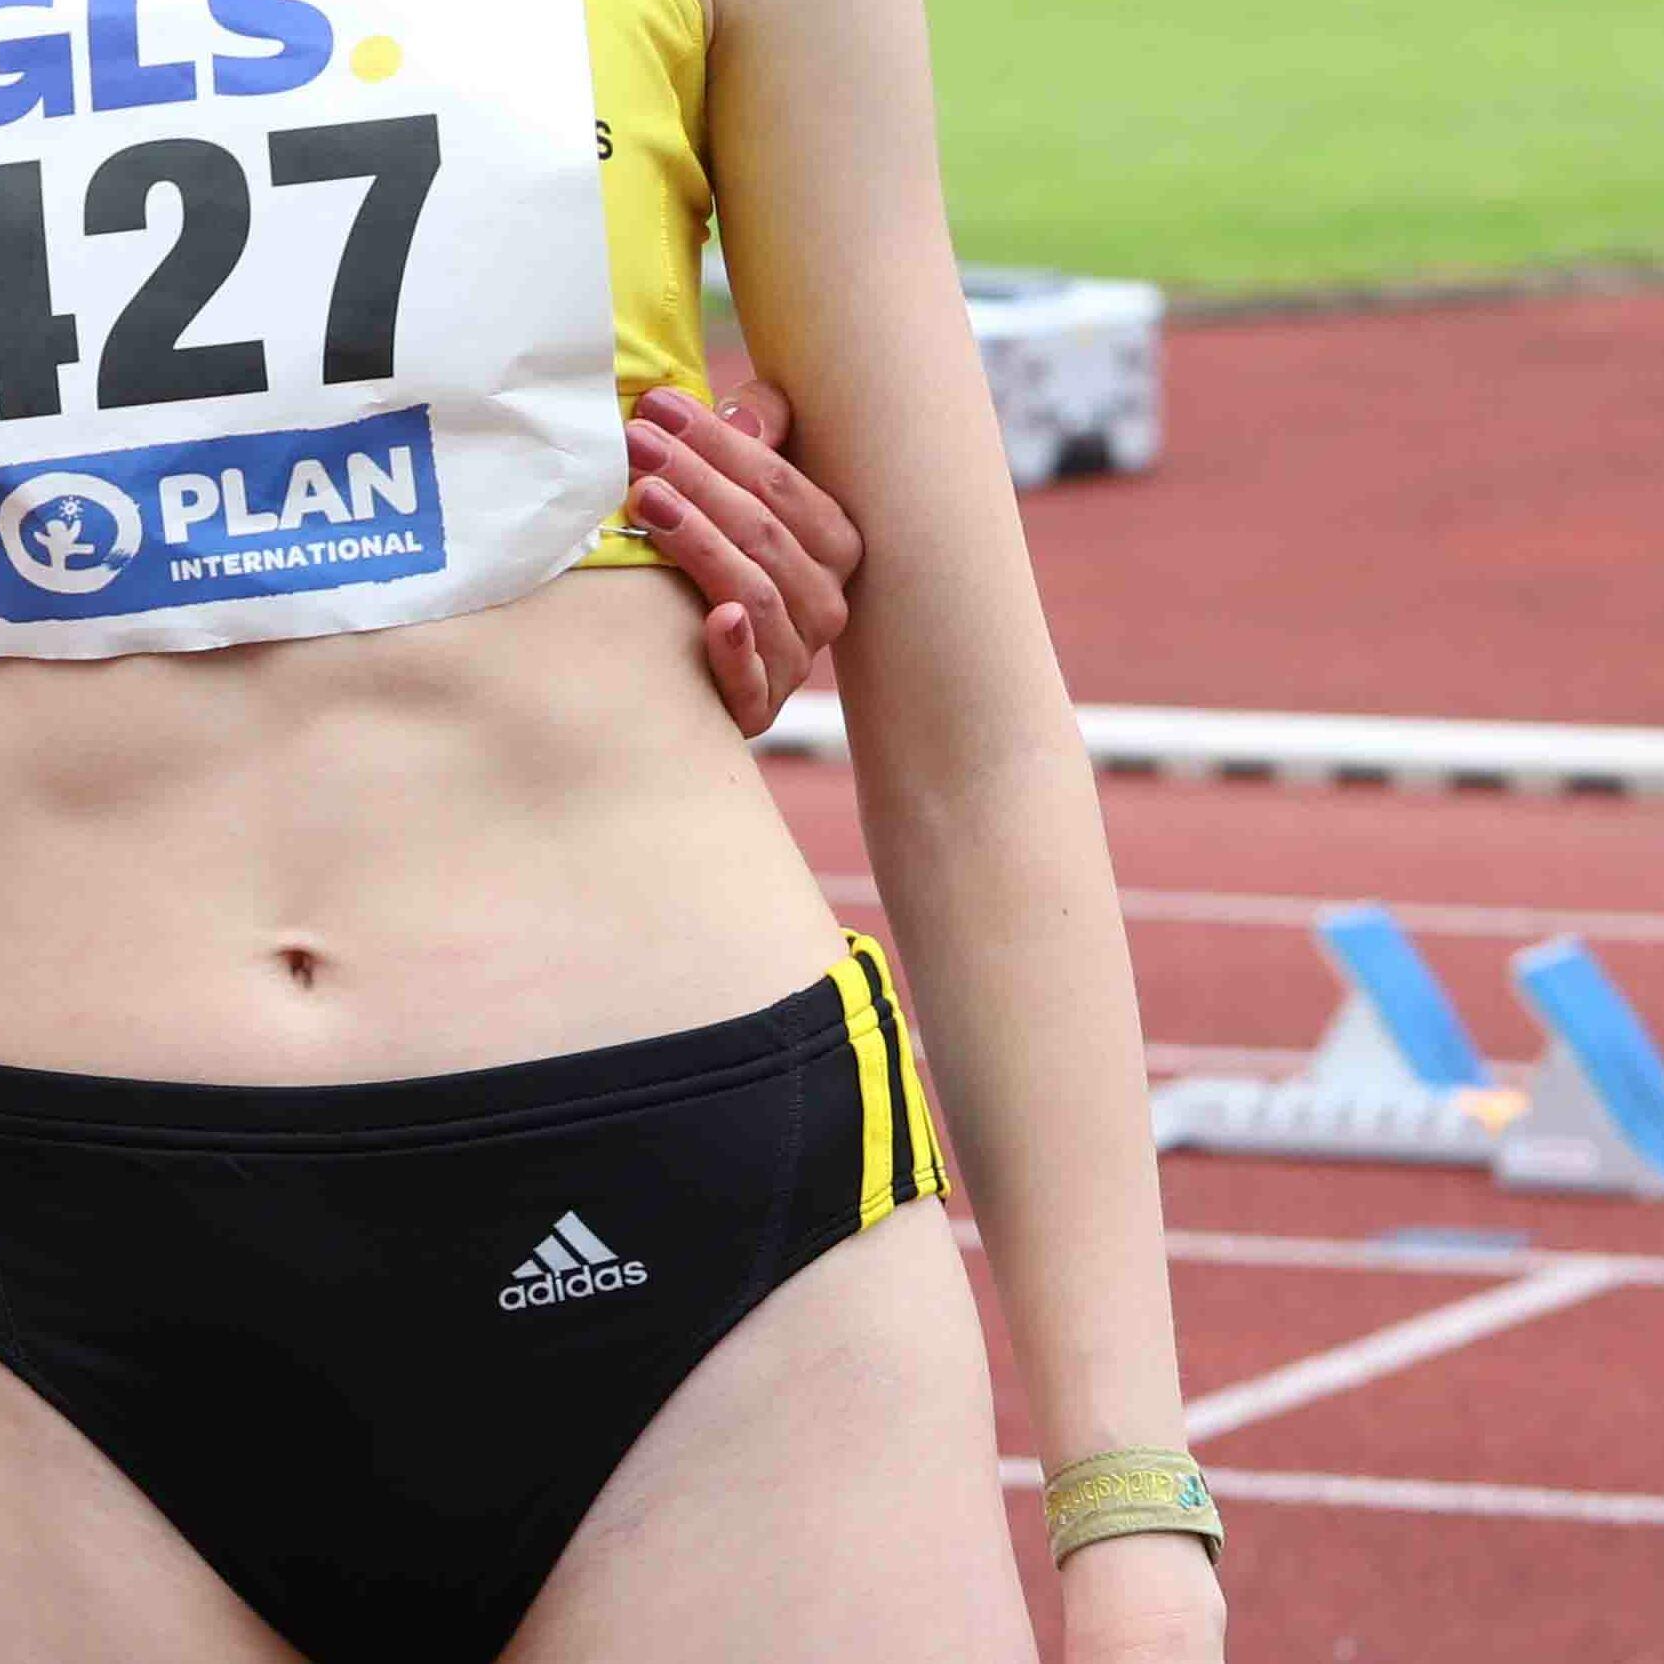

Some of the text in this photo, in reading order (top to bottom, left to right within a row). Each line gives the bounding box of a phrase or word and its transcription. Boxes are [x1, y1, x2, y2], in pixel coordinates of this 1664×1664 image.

[160, 445, 418, 545] PLAN
[170, 533, 423, 582] INTERNATIONAL
[498, 1260, 648, 1311] adidas
